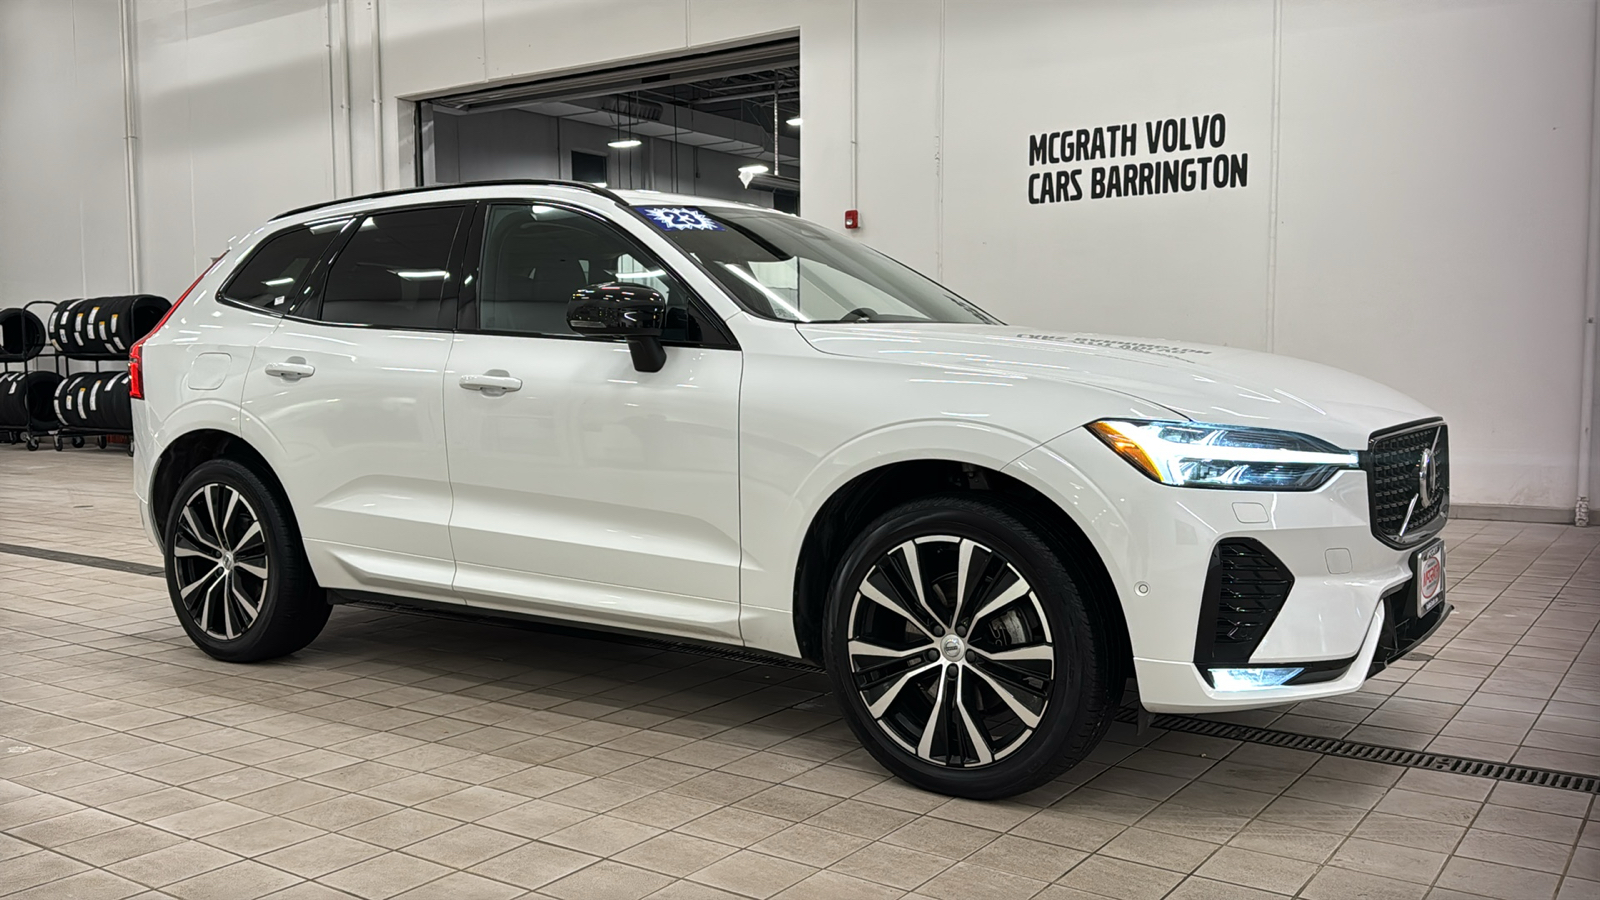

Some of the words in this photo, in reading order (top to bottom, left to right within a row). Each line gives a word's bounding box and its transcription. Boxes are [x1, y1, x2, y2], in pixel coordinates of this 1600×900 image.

[1029, 123, 1137, 167] MCGRATH
[1146, 113, 1226, 154] VOLVO
[1028, 169, 1083, 205] CARS
[1090, 153, 1248, 199] BARRINGTON
[663, 211, 702, 225] 23
